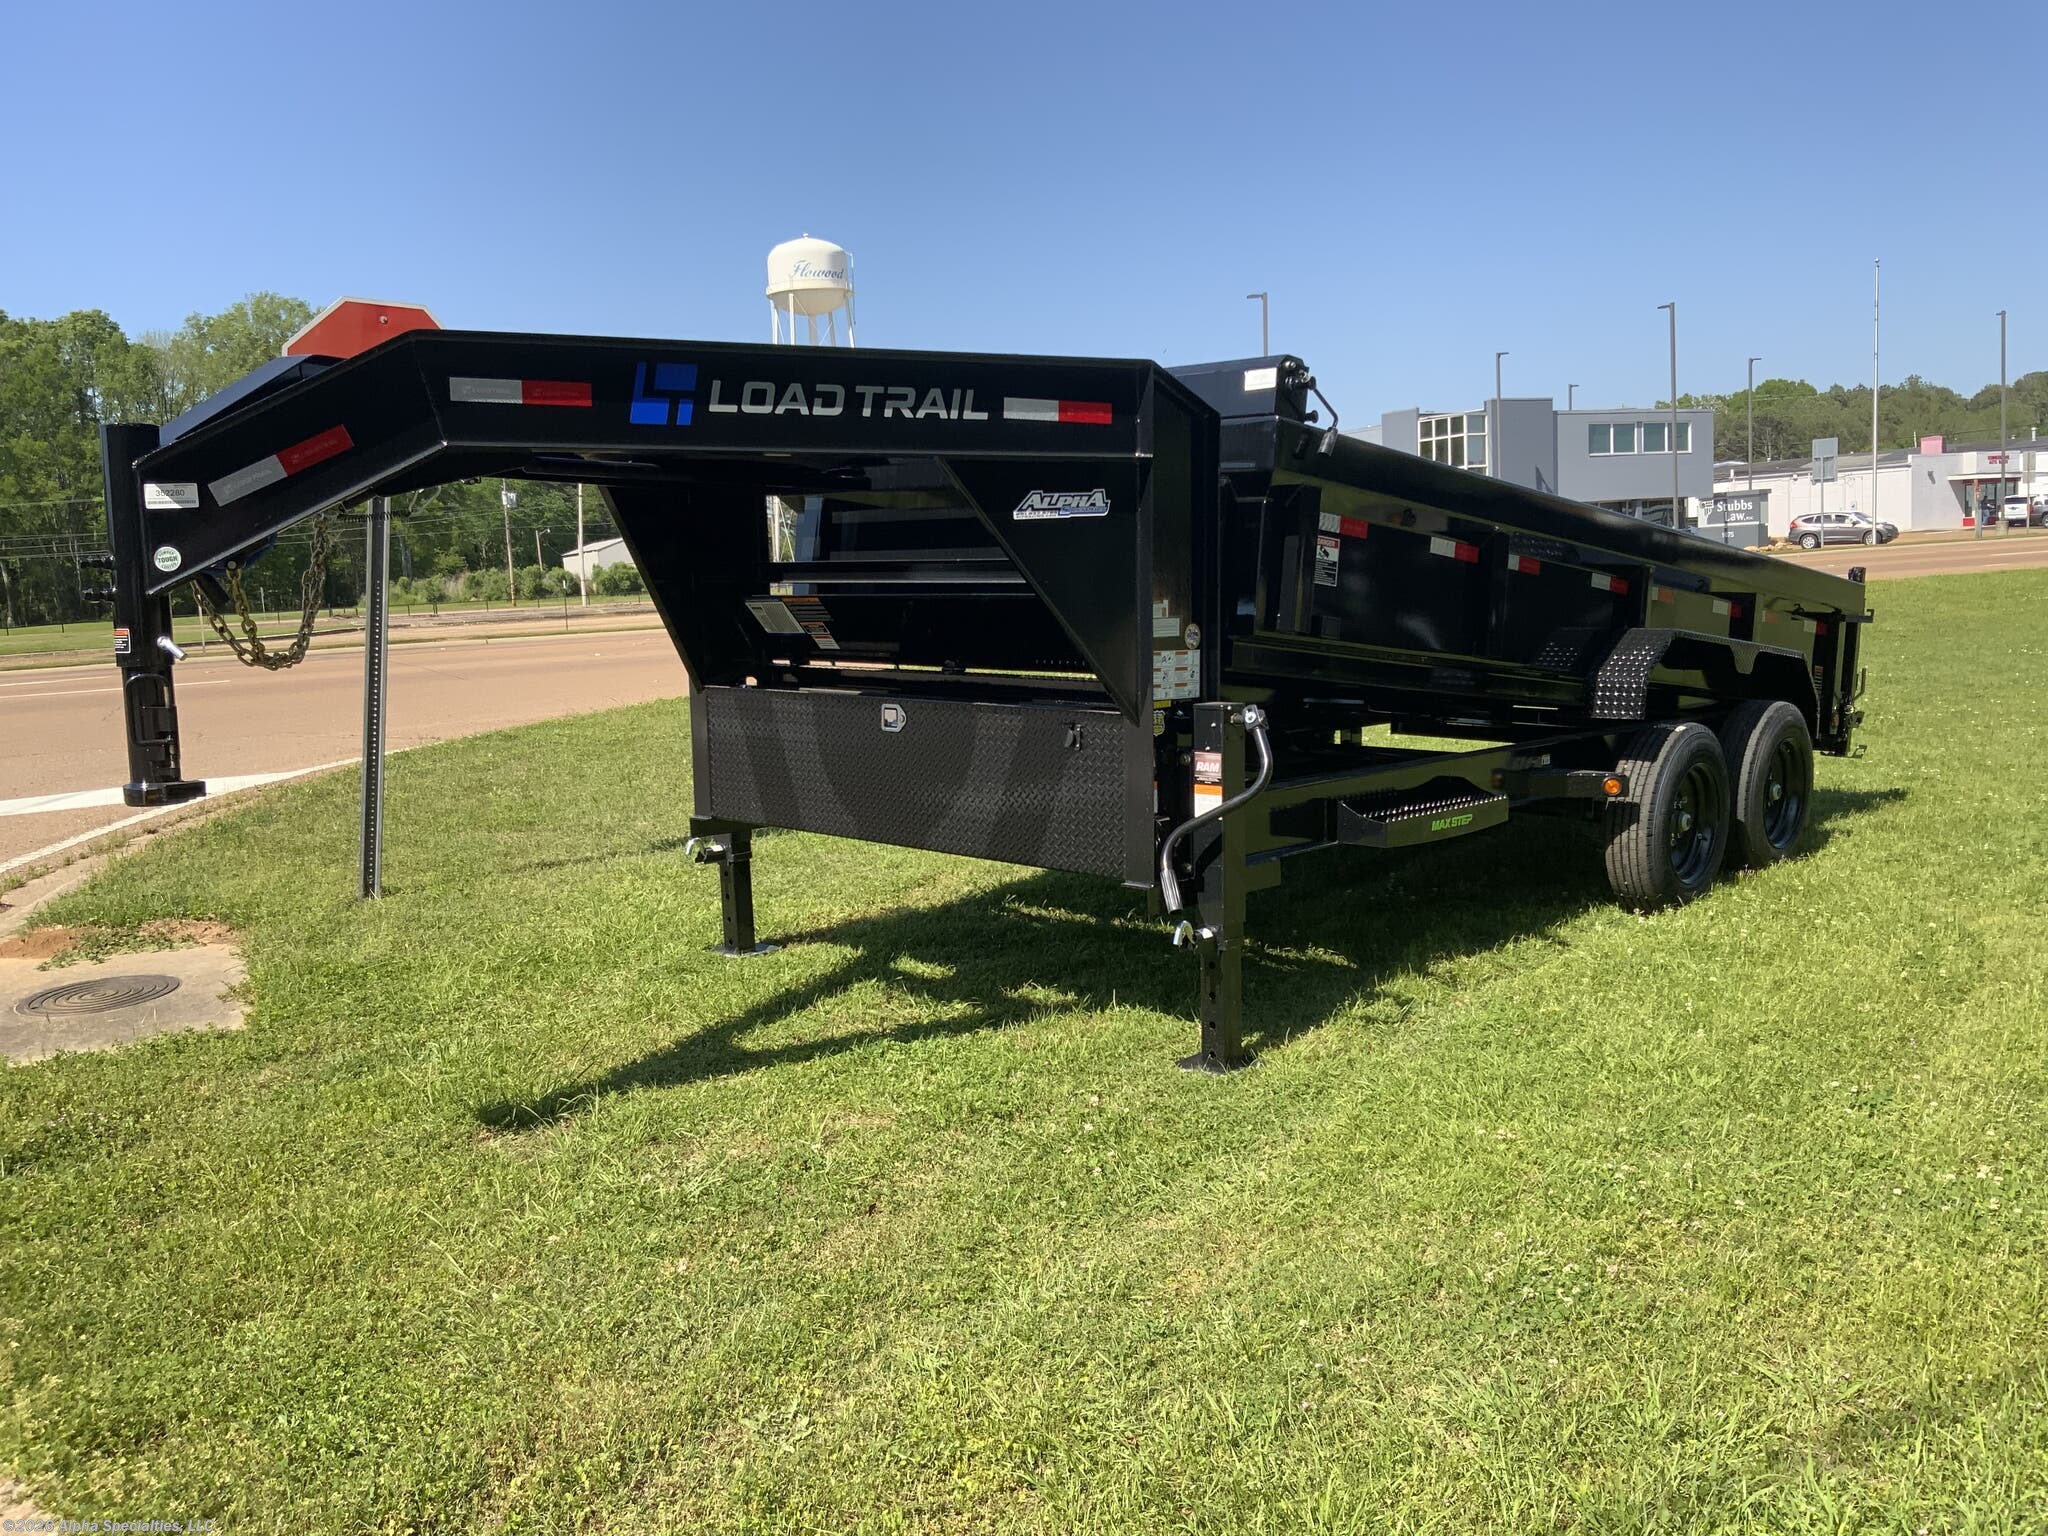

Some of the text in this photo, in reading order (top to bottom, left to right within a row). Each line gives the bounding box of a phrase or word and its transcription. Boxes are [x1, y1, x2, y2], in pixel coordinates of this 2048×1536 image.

[791, 260, 844, 279] Flowood
[709, 380, 989, 420] LOAD TRAIL
[1021, 492, 1106, 509] ALPHA
[1716, 500, 1753, 512] Stubbs
[1196, 761, 1220, 773] RAM
[1431, 813, 1473, 831] MAX STEP
